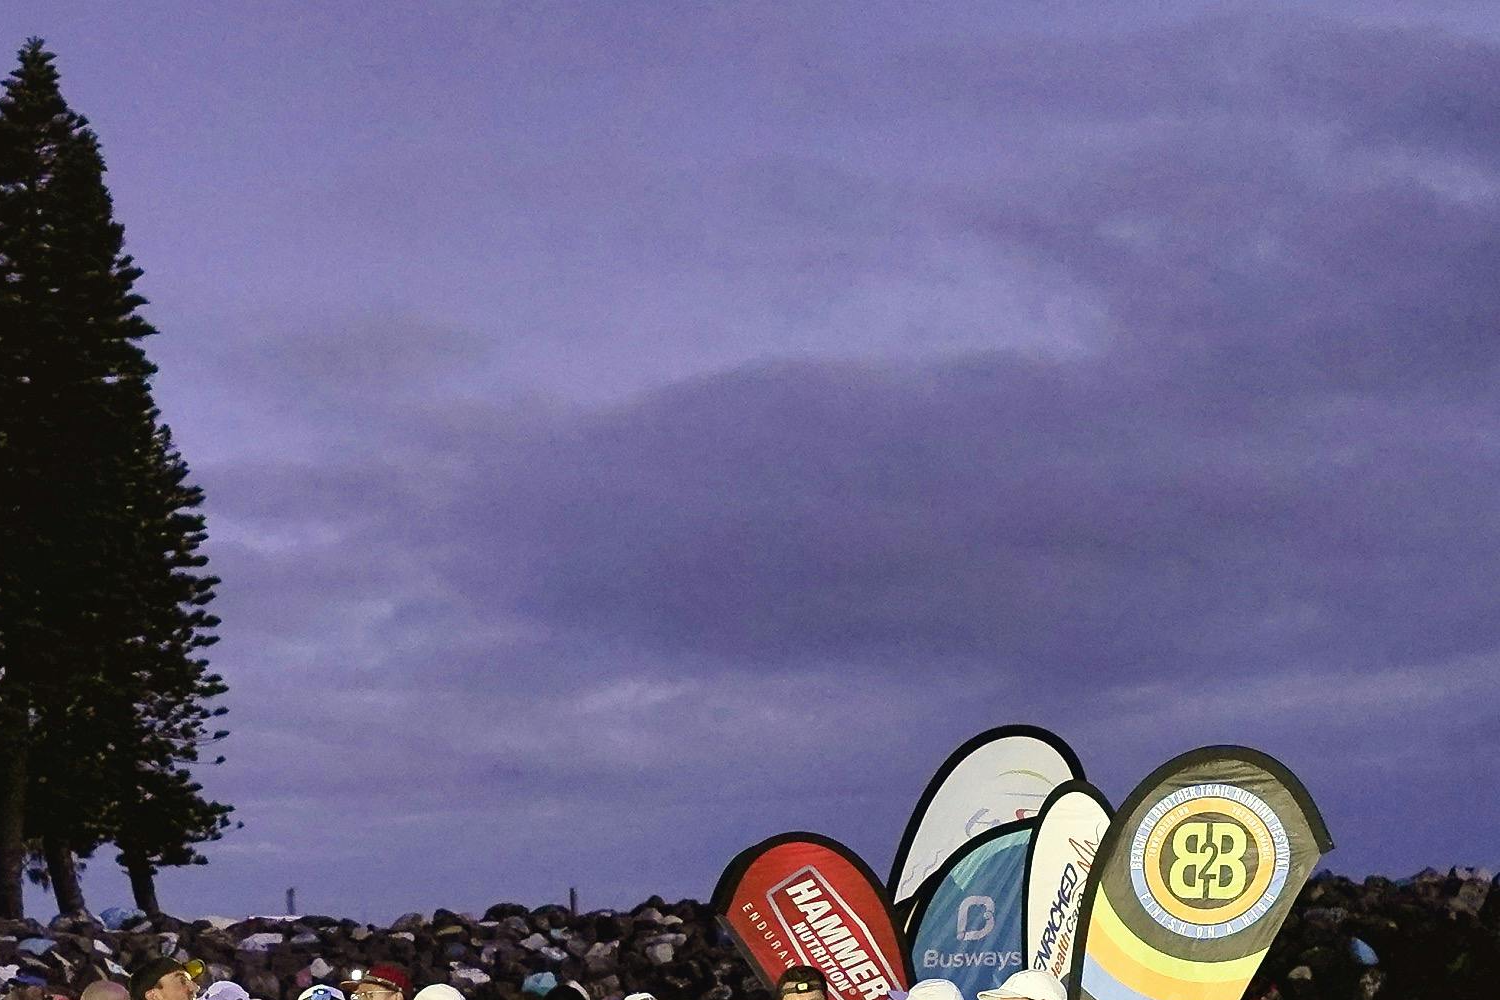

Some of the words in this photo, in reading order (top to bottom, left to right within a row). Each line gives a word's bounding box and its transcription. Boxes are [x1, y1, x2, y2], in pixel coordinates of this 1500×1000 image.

[1199, 784, 1231, 797] TRAIL
[1234, 786, 1276, 822] RUNNING
[1270, 823, 1290, 870] FESTIVAL
[1140, 892, 1186, 934] FINISH
[1197, 926, 1214, 938] ON
[1226, 925, 1235, 935] A
[1241, 892, 1276, 927] HIGH
[923, 949, 1022, 971] Busways
